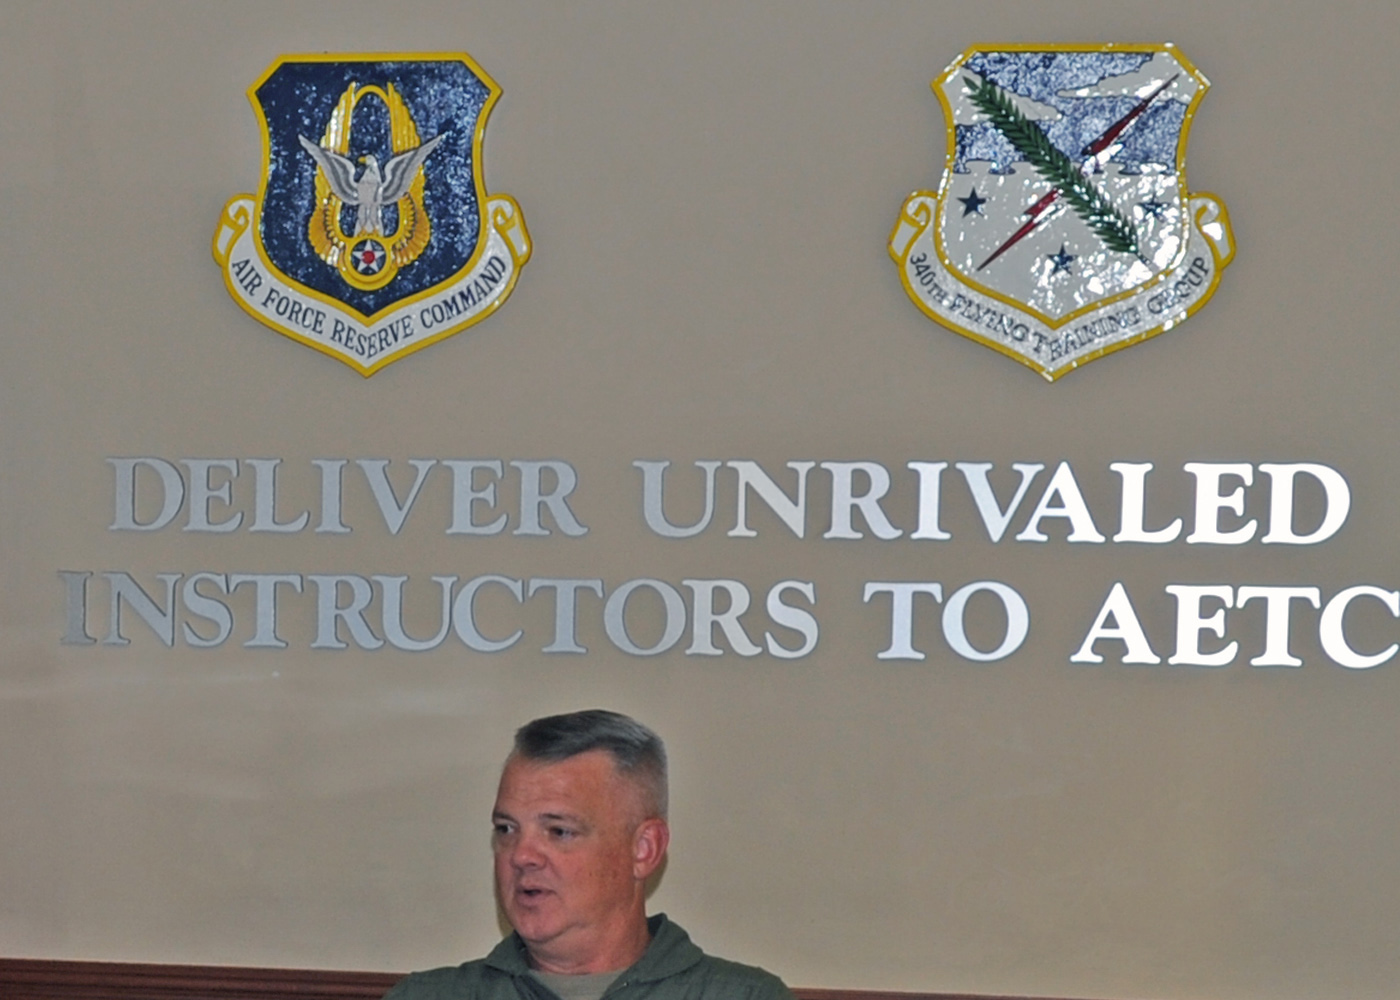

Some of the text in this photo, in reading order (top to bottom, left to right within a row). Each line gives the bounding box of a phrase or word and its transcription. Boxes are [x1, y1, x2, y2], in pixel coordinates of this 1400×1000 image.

[232, 255, 507, 358] AIR FORCE RESERVE COMMAND
[910, 252, 1211, 361] 340TH FLYING TRAINING GROUP
[105, 456, 1352, 545] DELIVER UNRIVALED
[56, 570, 1399, 669] INSTRUCTORS TO AETC
